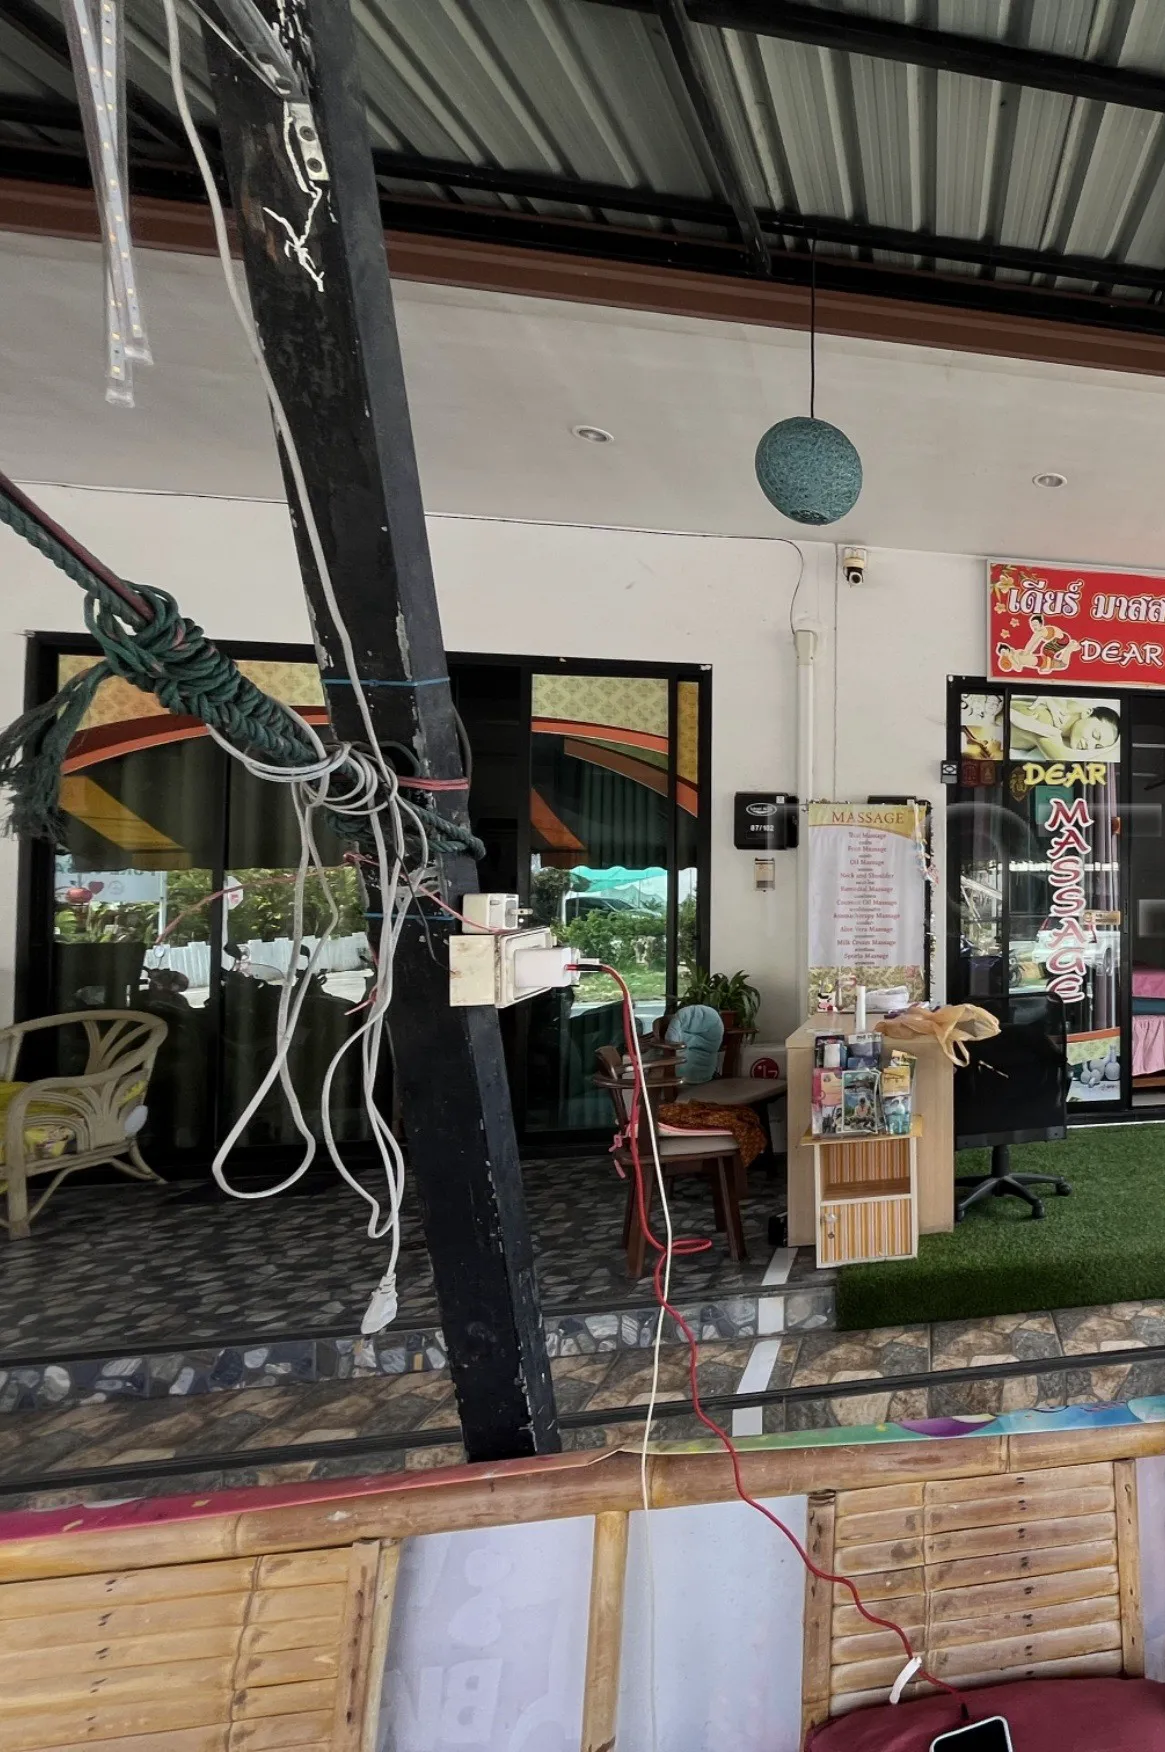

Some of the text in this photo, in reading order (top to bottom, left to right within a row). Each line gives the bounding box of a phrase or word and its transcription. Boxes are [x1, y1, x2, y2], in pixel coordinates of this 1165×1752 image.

[1007, 580, 1084, 617] เดียร์
[1080, 638, 1164, 667] DEAR
[1022, 762, 1107, 788] DEAR
[831, 811, 905, 824] MASSAGE
[1045, 797, 1094, 1005] MASSAGE
